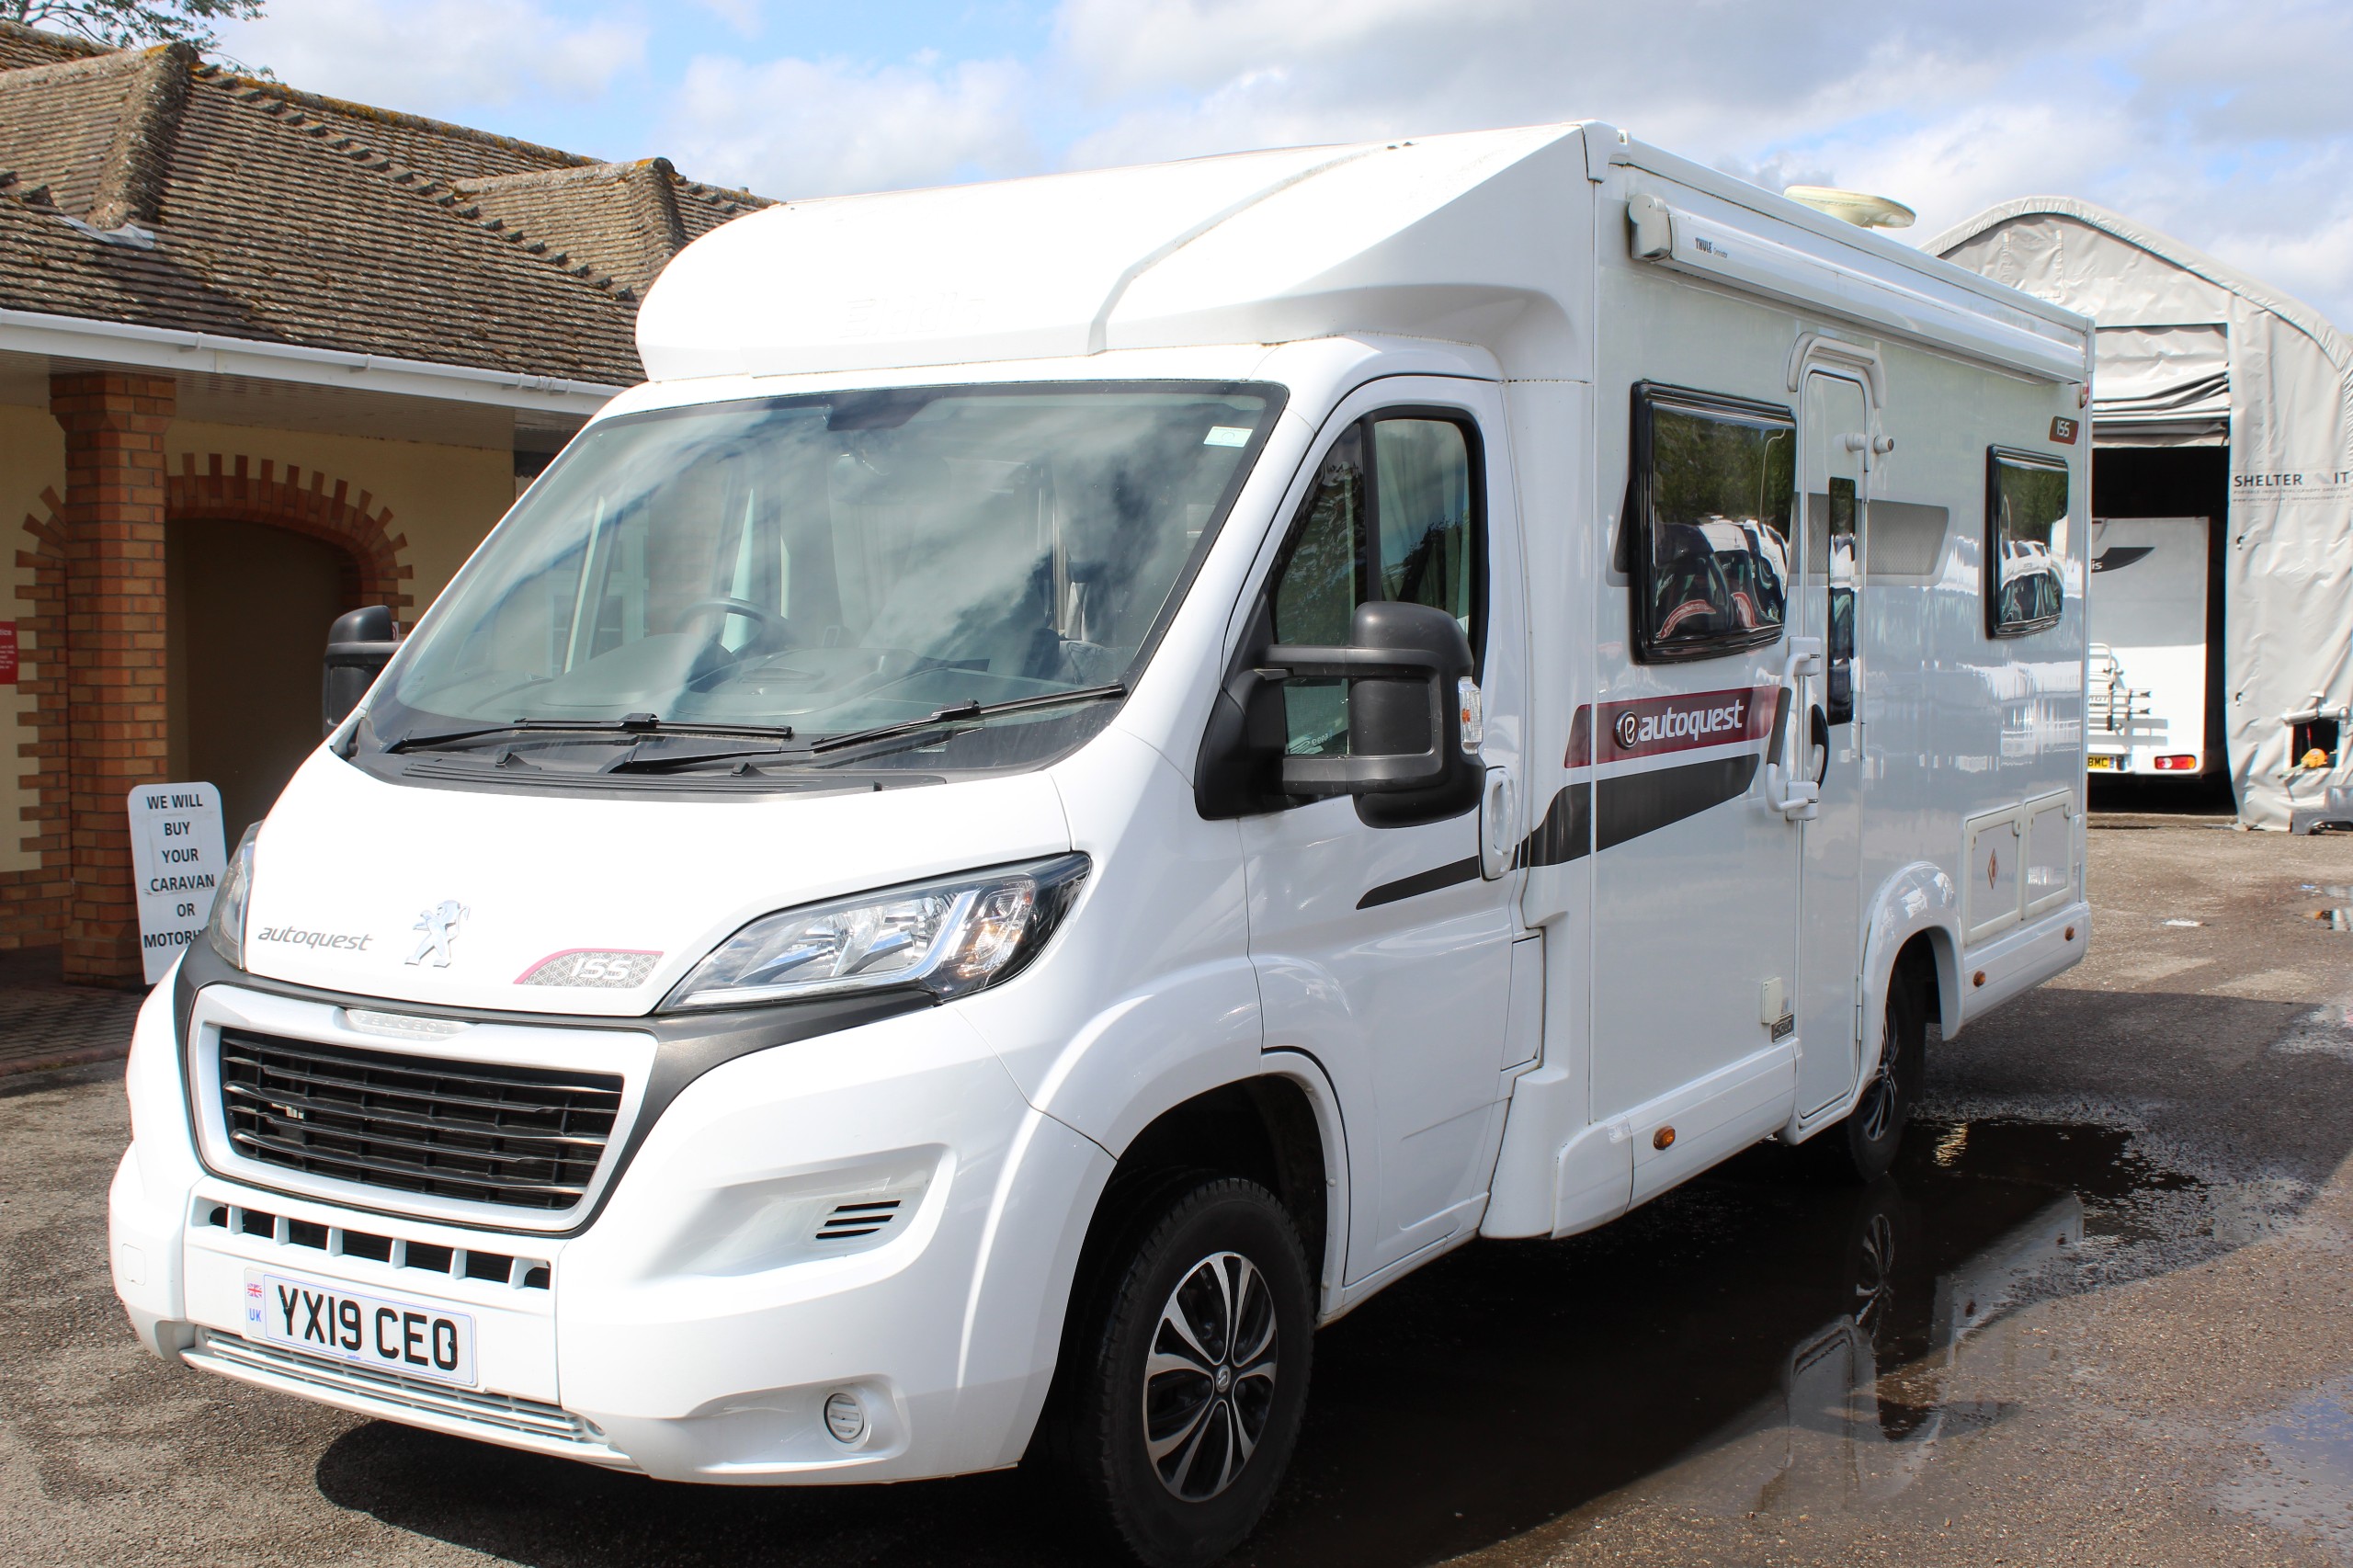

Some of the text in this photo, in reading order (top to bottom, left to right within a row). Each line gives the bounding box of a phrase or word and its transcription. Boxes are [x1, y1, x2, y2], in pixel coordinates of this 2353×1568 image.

[2057, 420, 2070, 437] 155
[2234, 472, 2349, 487] SHELTER IT
[1639, 699, 1744, 741] autoquest
[147, 793, 203, 810] WE WILL
[164, 822, 191, 835] BUY
[162, 848, 199, 863] YOUR
[151, 874, 215, 892] CARAVAN
[176, 903, 195, 917] OR
[258, 926, 374, 950] autoquest
[571, 958, 632, 981] 155
[249, 1308, 261, 1322] UK
[278, 1285, 459, 1371] YX19 CEO
